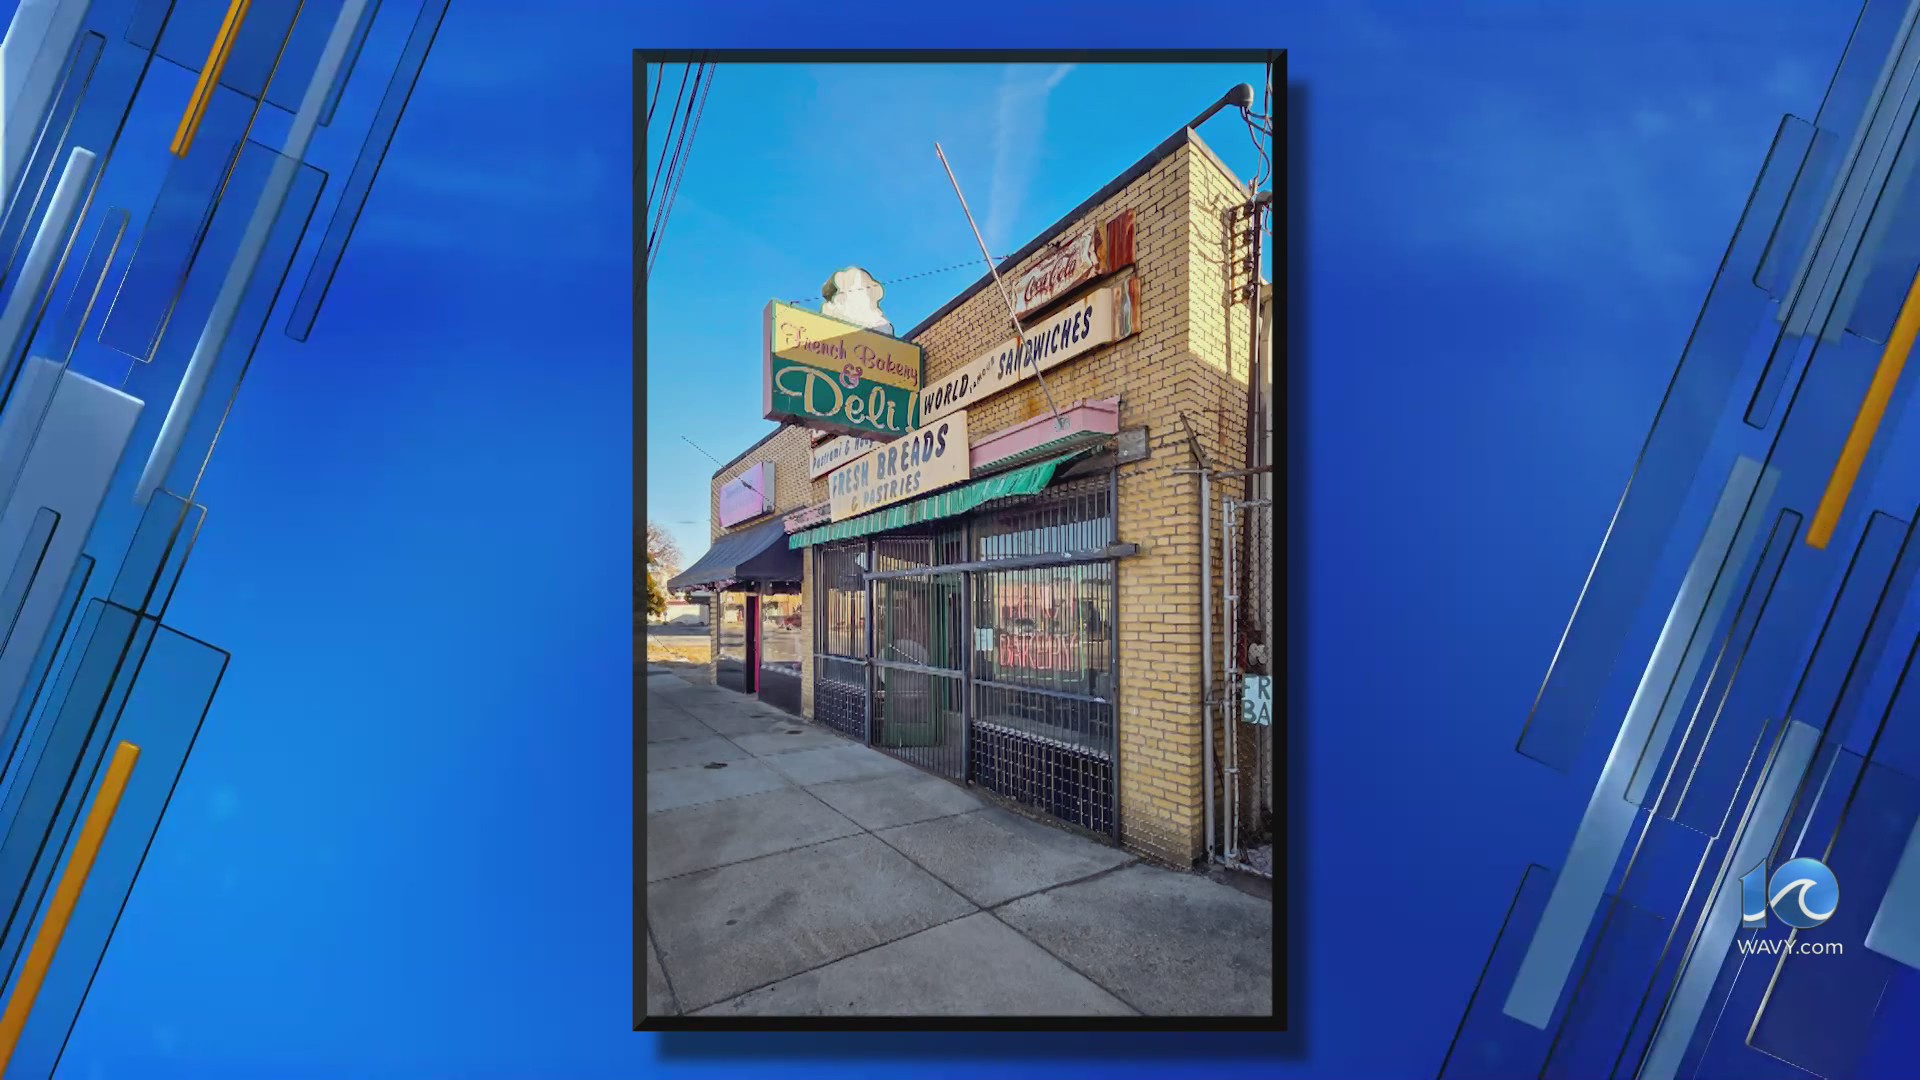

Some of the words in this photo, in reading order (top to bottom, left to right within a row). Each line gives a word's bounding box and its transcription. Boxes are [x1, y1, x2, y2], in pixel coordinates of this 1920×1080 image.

[781, 322, 847, 359] French
[853, 343, 918, 386] Bakery
[839, 363, 863, 389] &
[923, 374, 969, 415] WORLD
[997, 305, 1093, 380] SANDWICHES
[832, 460, 869, 498] FRESH
[876, 423, 949, 480] BREADS
[863, 470, 921, 508] PASTRIES
